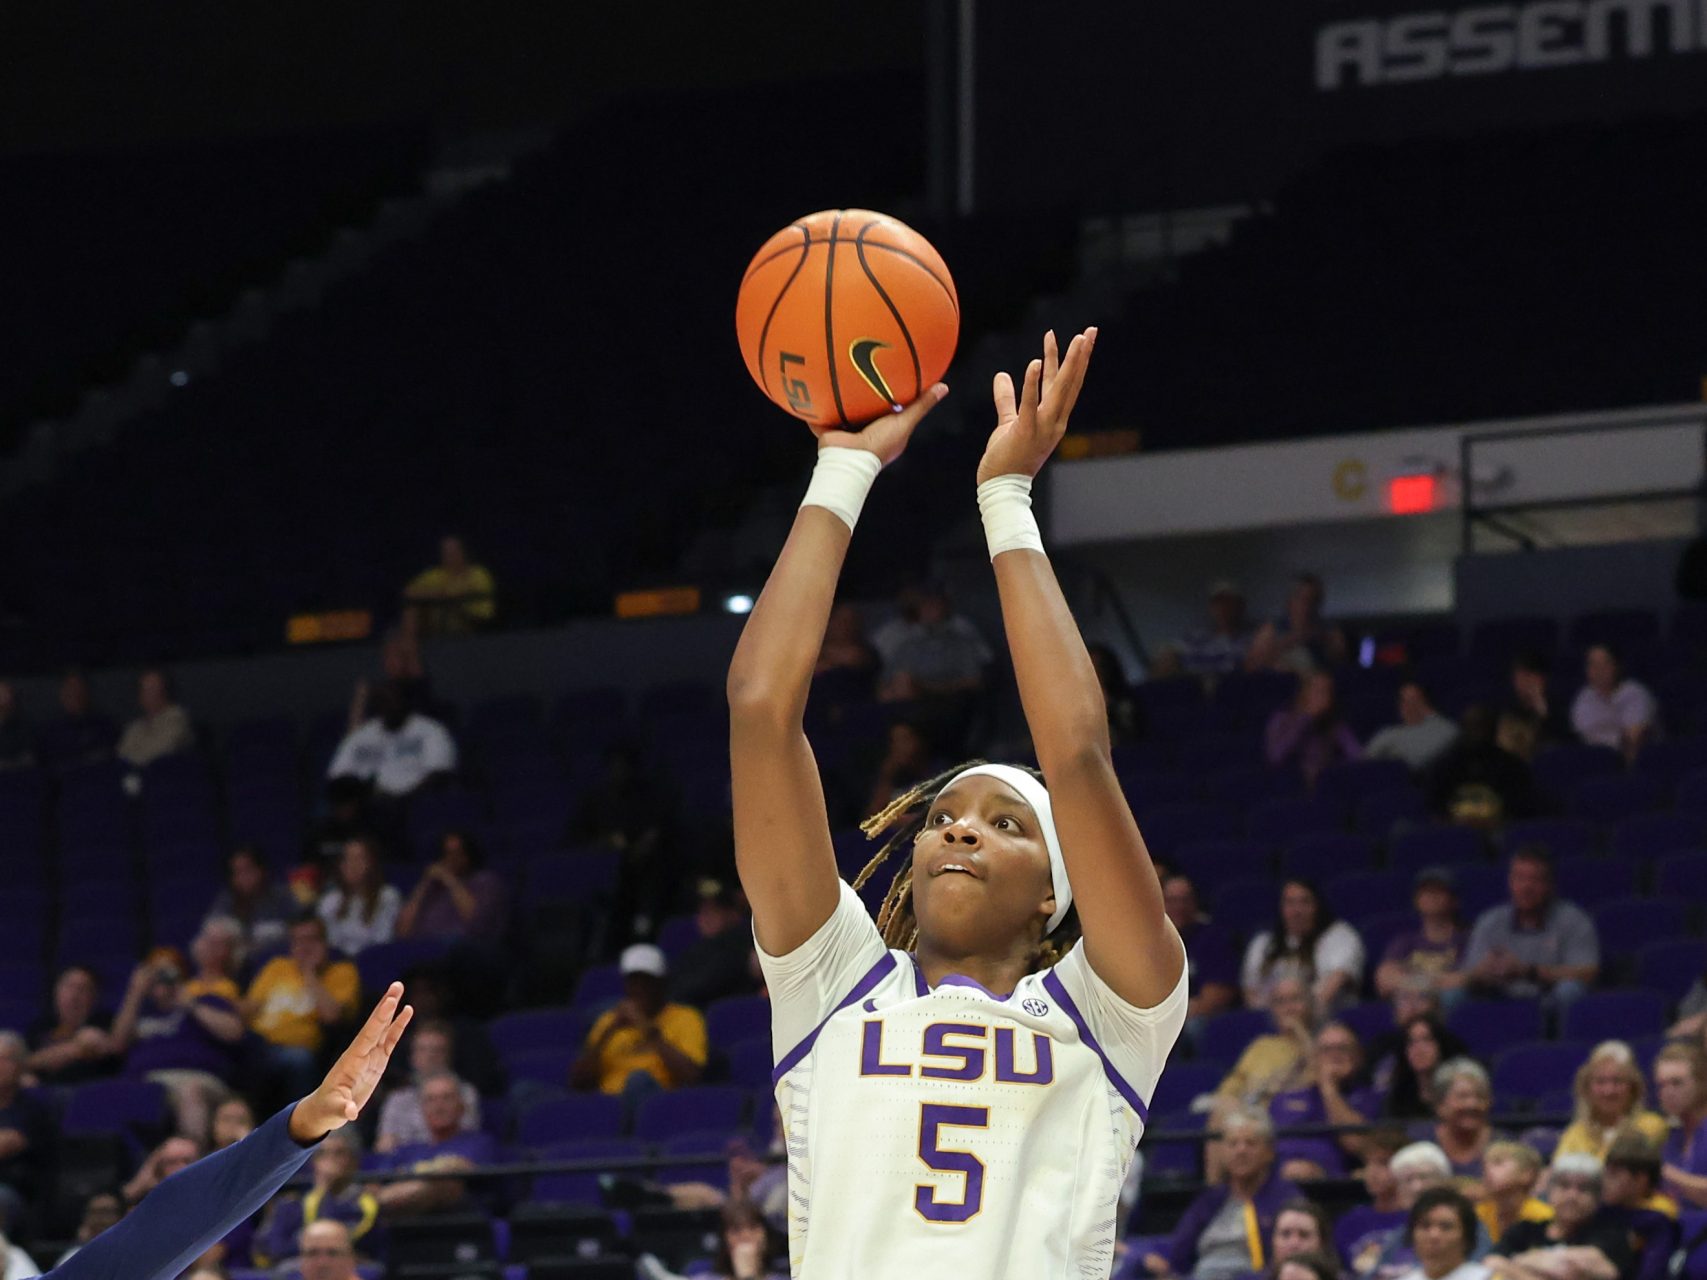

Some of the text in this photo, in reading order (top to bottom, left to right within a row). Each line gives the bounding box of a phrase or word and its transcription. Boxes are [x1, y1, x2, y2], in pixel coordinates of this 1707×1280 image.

[1315, 0, 1707, 90] ASSEM
[1023, 999, 1048, 1016] SEC
[859, 1018, 1056, 1088] LSU
[913, 1100, 992, 1226] 5
